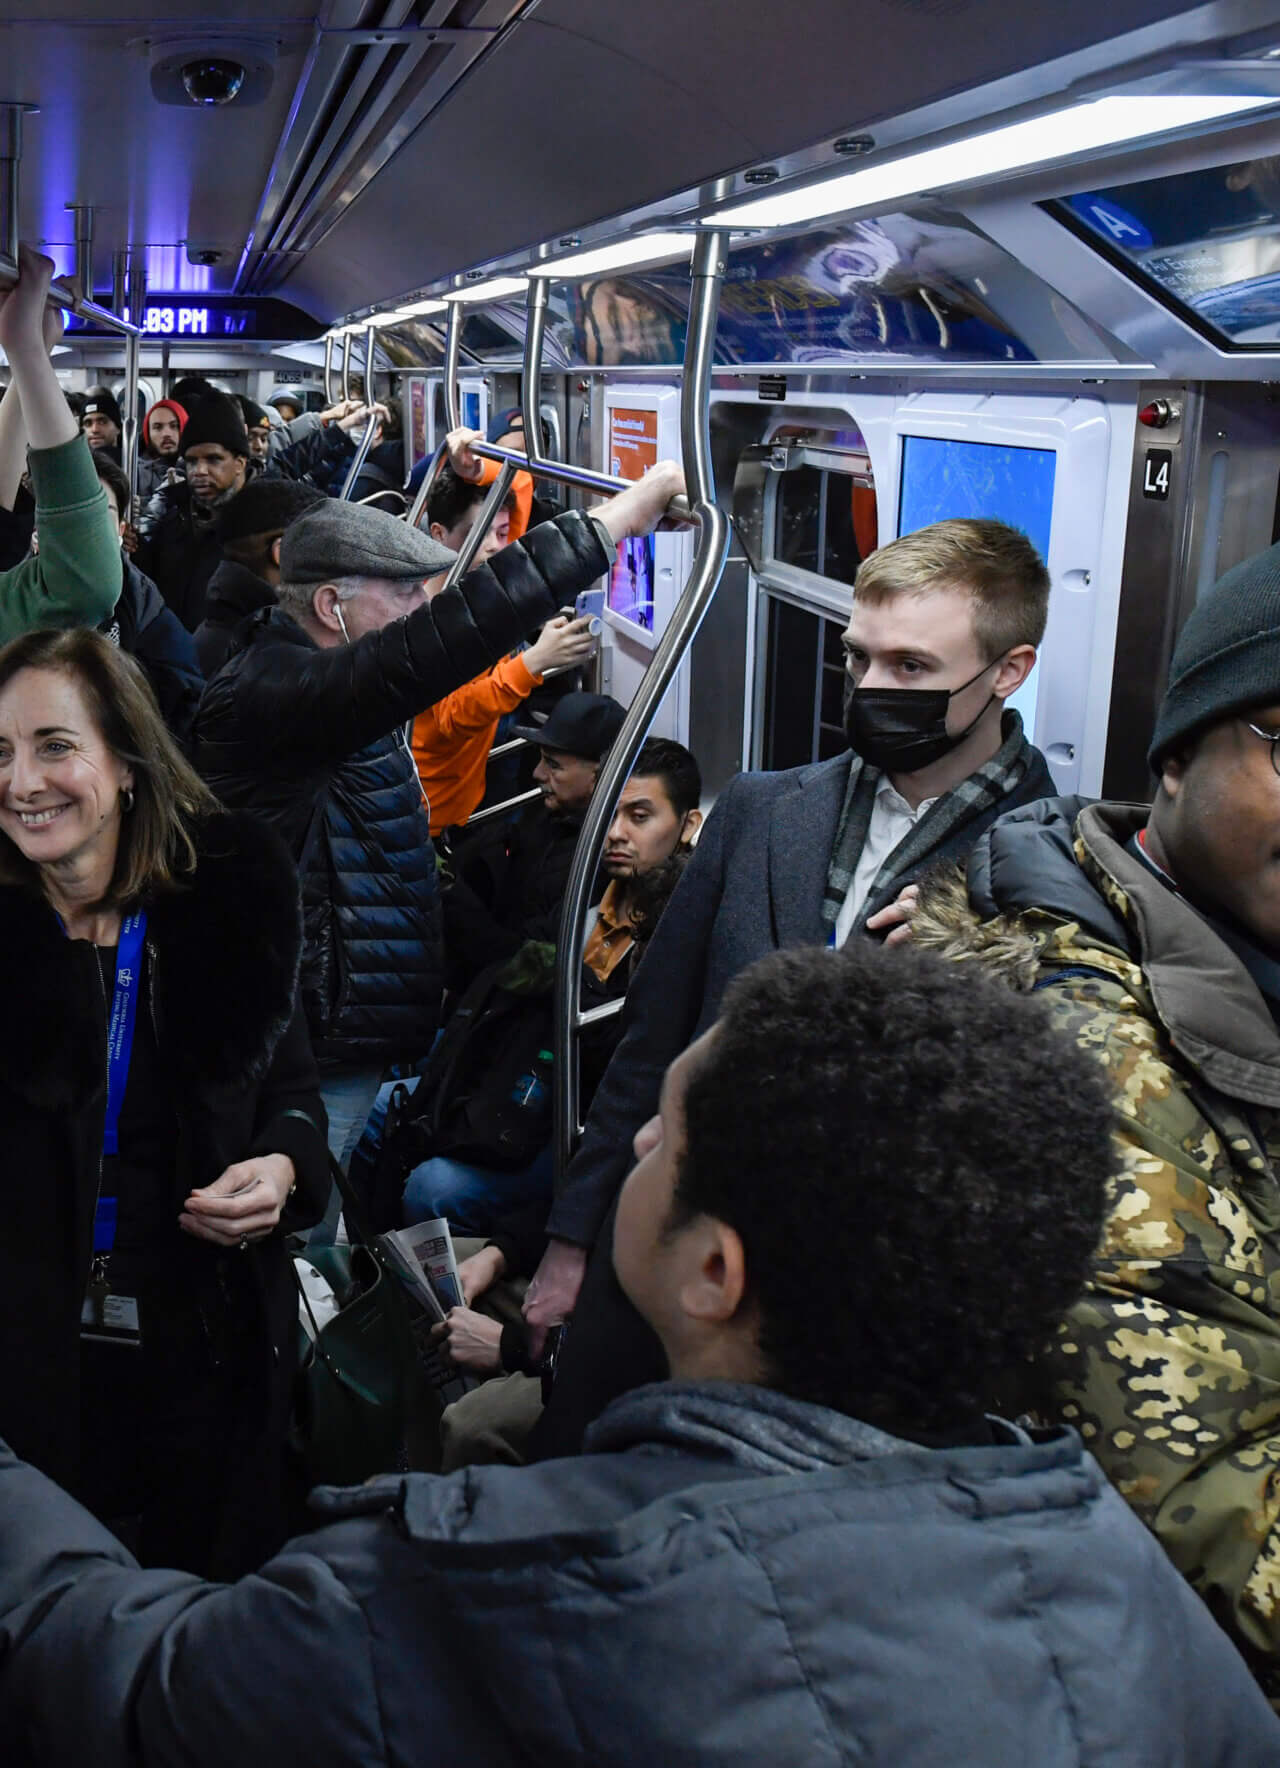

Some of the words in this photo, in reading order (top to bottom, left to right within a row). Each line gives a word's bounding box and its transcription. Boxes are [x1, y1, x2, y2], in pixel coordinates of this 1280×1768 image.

[1090, 206, 1140, 238] A
[178, 308, 207, 334] PM
[1145, 459, 1169, 493] L4
